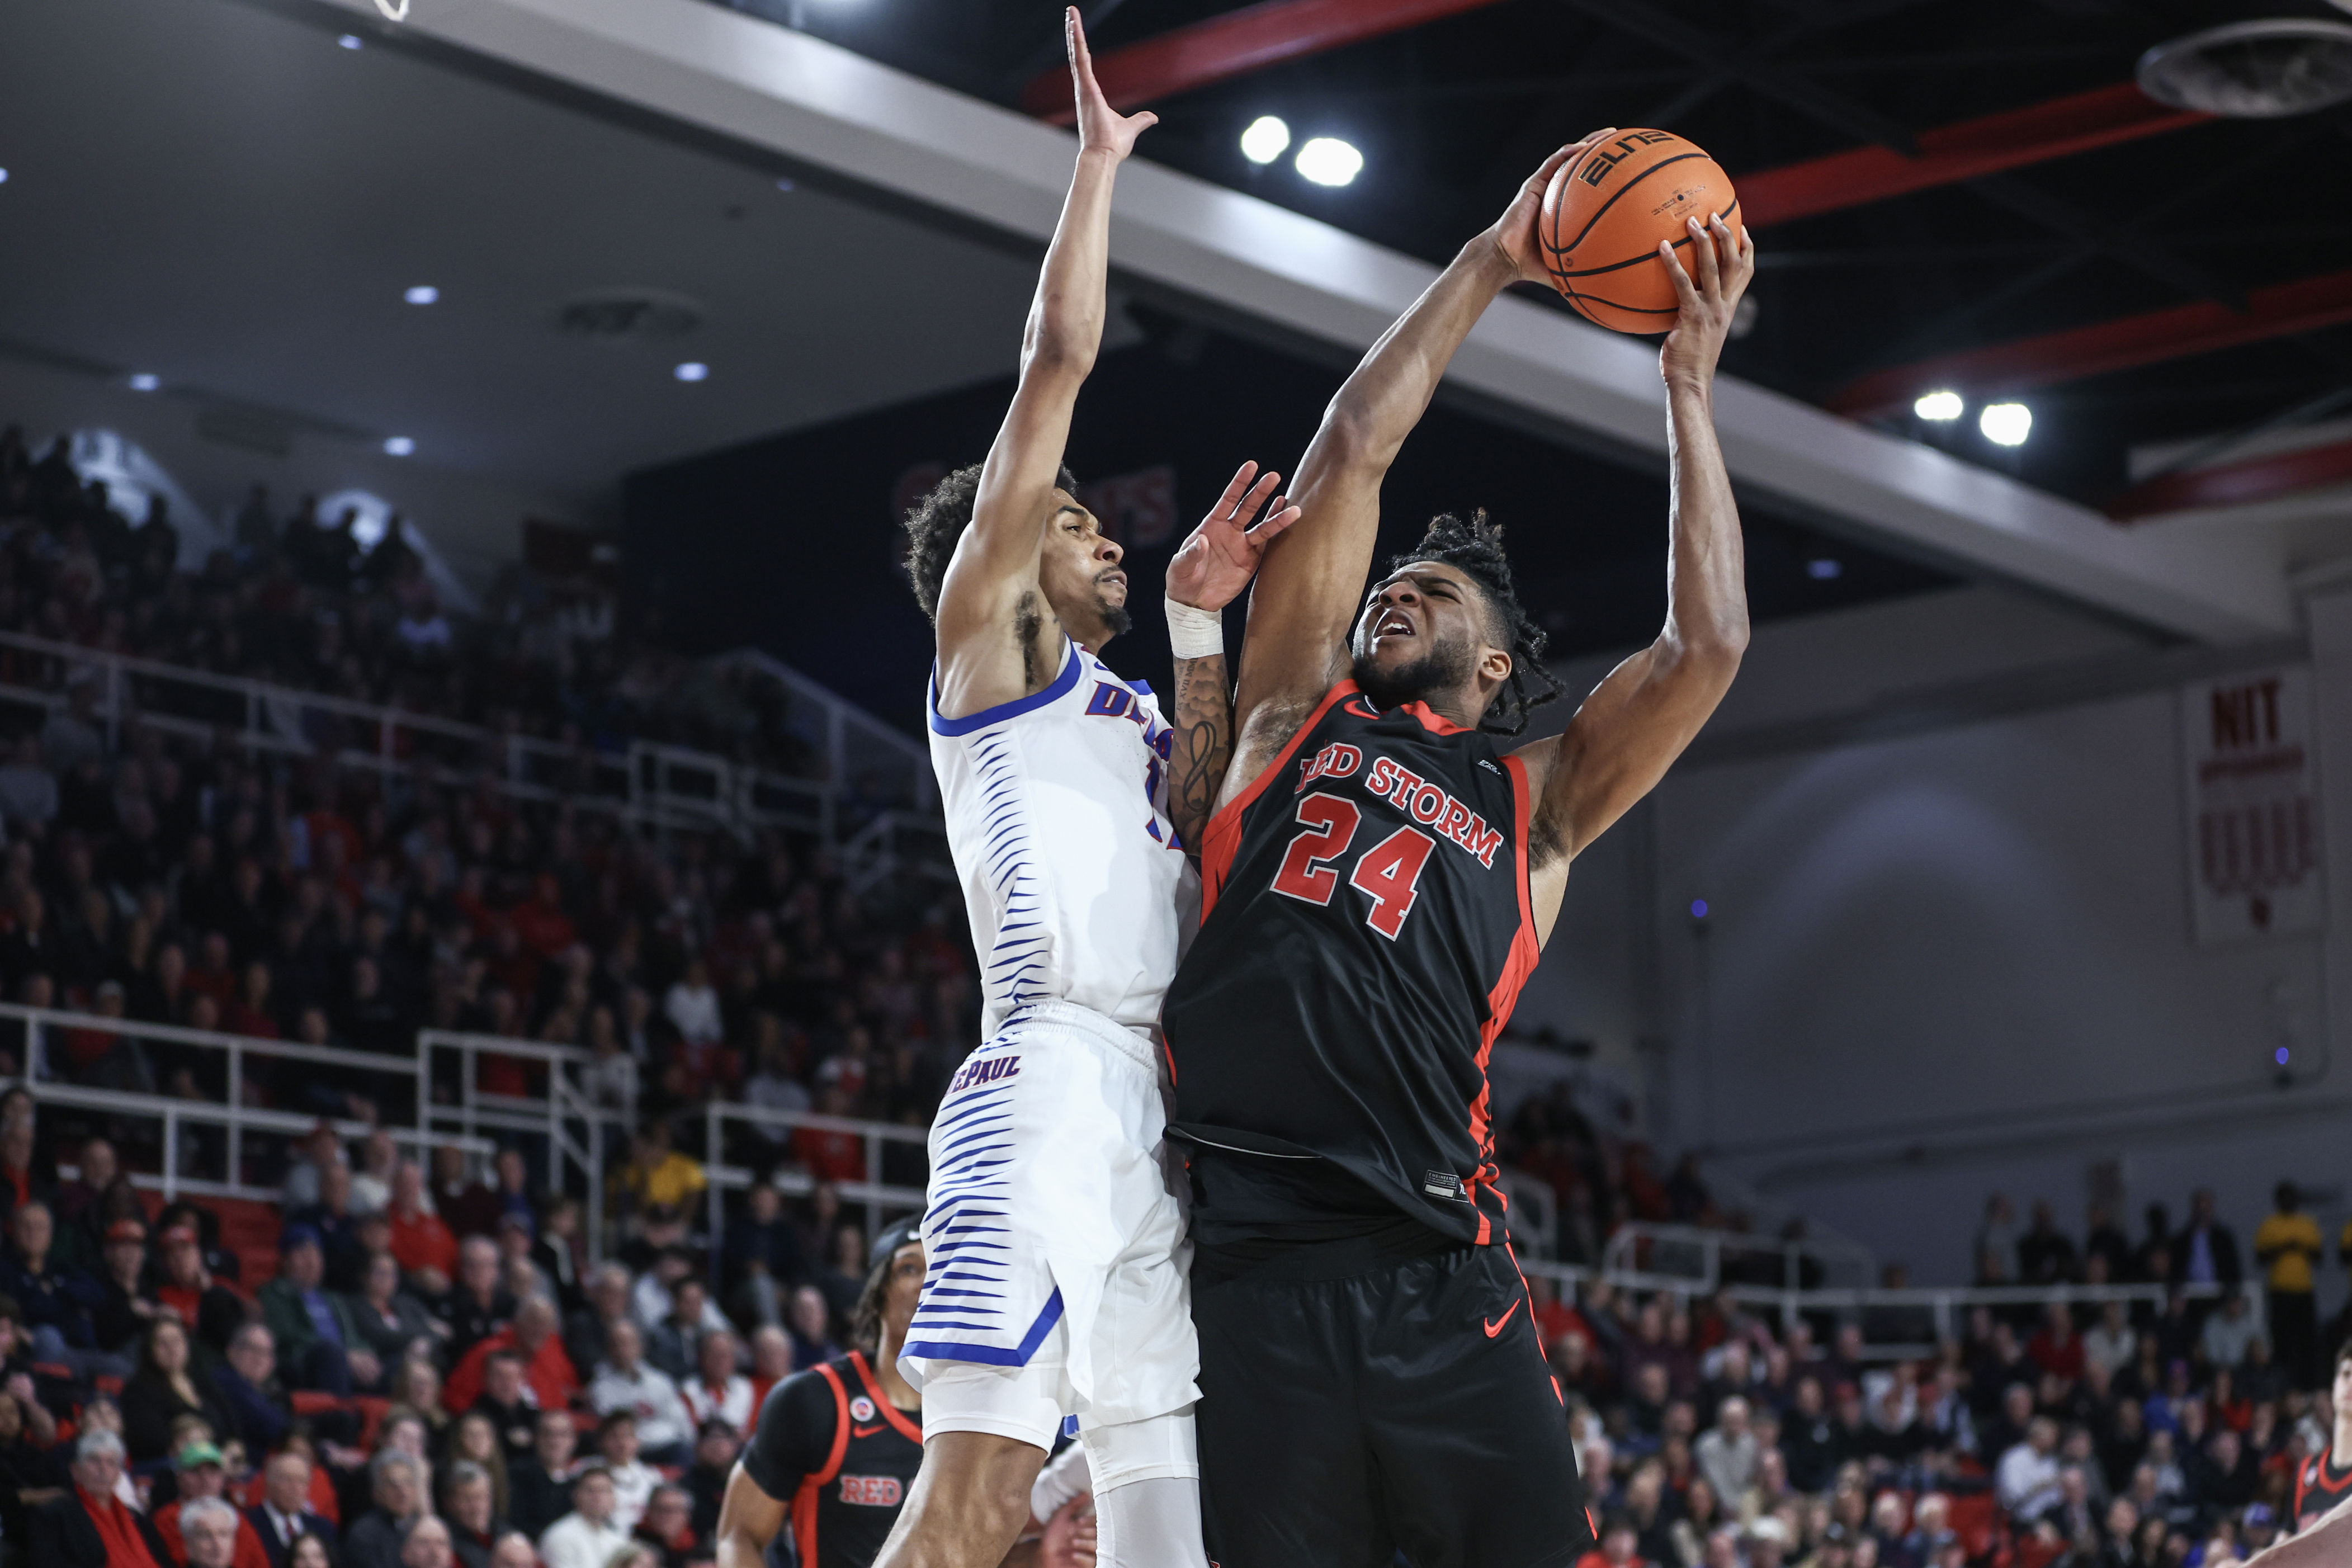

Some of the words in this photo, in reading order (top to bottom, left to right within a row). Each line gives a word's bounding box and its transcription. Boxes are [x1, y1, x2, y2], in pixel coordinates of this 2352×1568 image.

[1578, 131, 1674, 187] ELITE
[2212, 678, 2280, 749] NIT
[1364, 756, 1504, 871] STORM
[1269, 791, 1437, 942] 24
[946, 1055, 1022, 1095] EPAUL
[839, 1475, 903, 1506] RED
